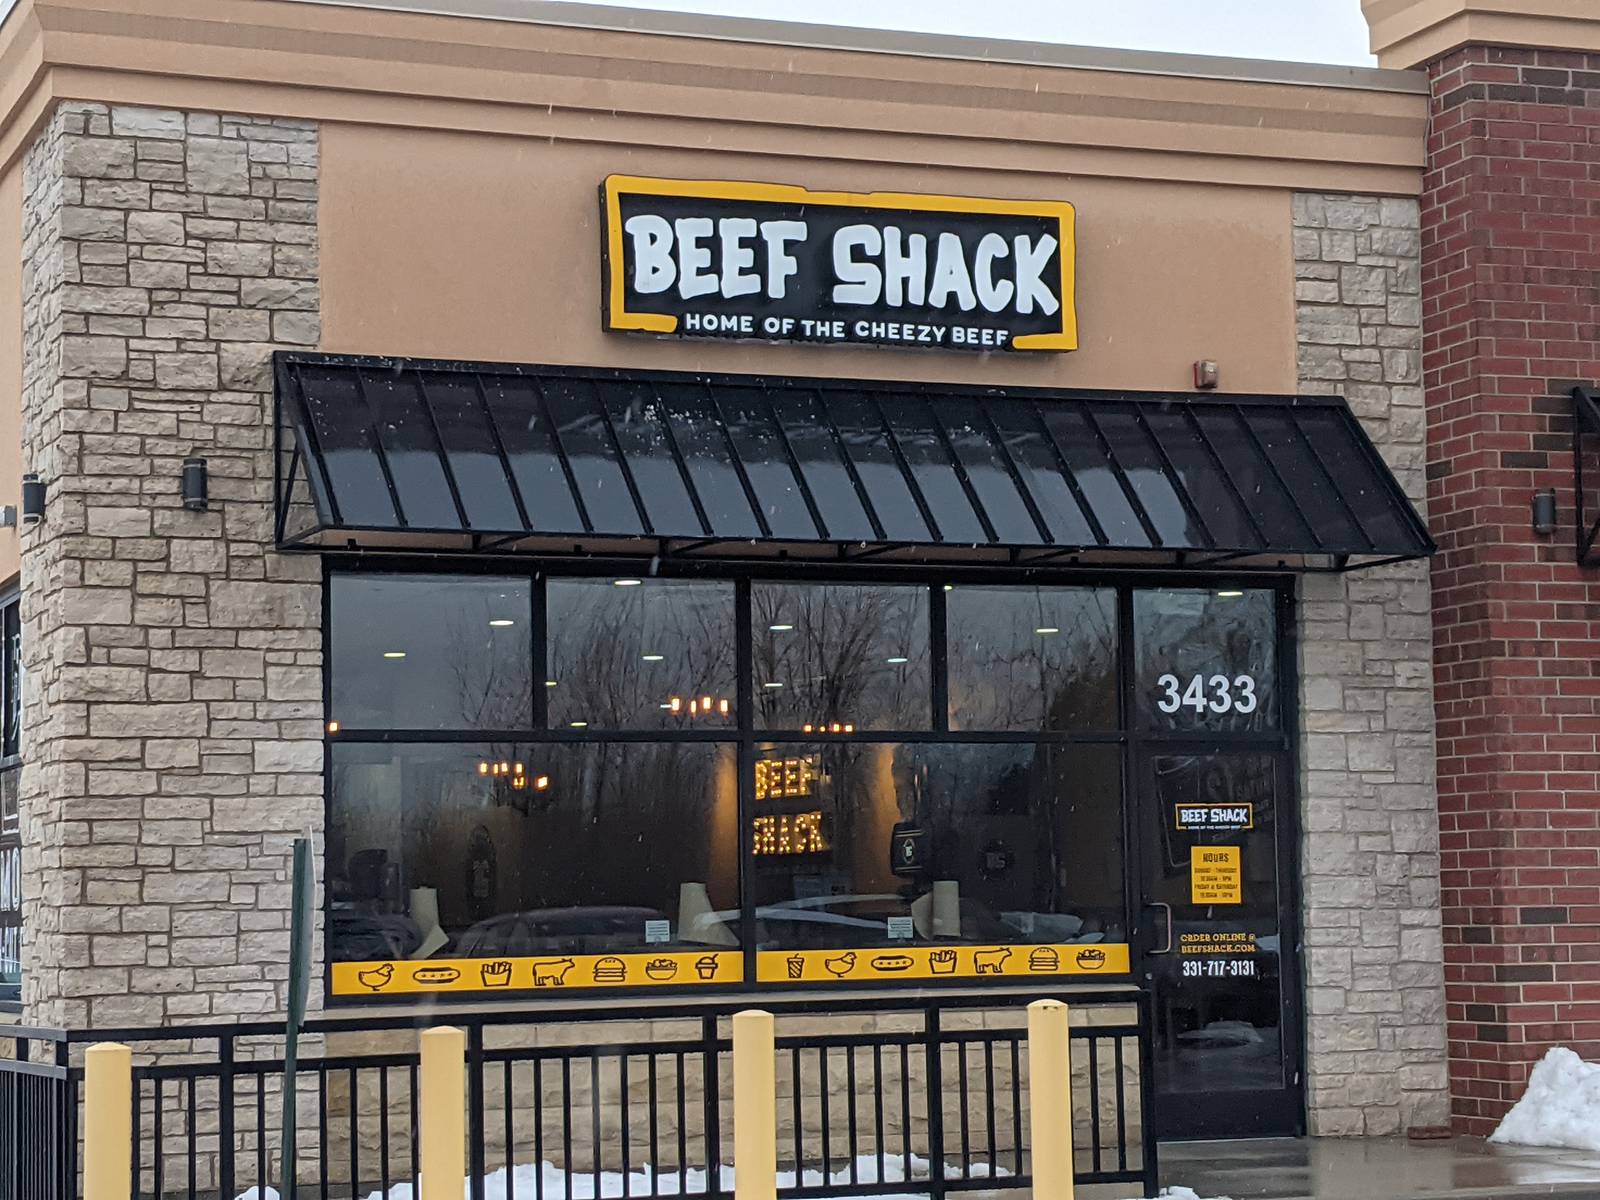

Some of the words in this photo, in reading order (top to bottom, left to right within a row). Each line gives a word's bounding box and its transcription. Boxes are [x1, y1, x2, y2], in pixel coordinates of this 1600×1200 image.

[624, 214, 807, 300] BEEF
[832, 223, 1060, 317] SHACK
[685, 313, 753, 333] HOME
[764, 317, 796, 336] OF
[801, 319, 845, 338] THE
[855, 320, 945, 344] CHEEZY
[952, 326, 1010, 346] BEEF
[1157, 673, 1257, 713] 3433
[754, 756, 814, 800] BEEF
[1180, 808, 1209, 823] BEEF
[1210, 808, 1248, 823] SHACK
[1202, 852, 1229, 863] HOURS
[1180, 933, 1211, 942] ORDER
[1212, 932, 1247, 942] ONLINE
[1181, 944, 1256, 954] BEEFSHACK.COM
[1182, 960, 1255, 977] 331-717-3131
